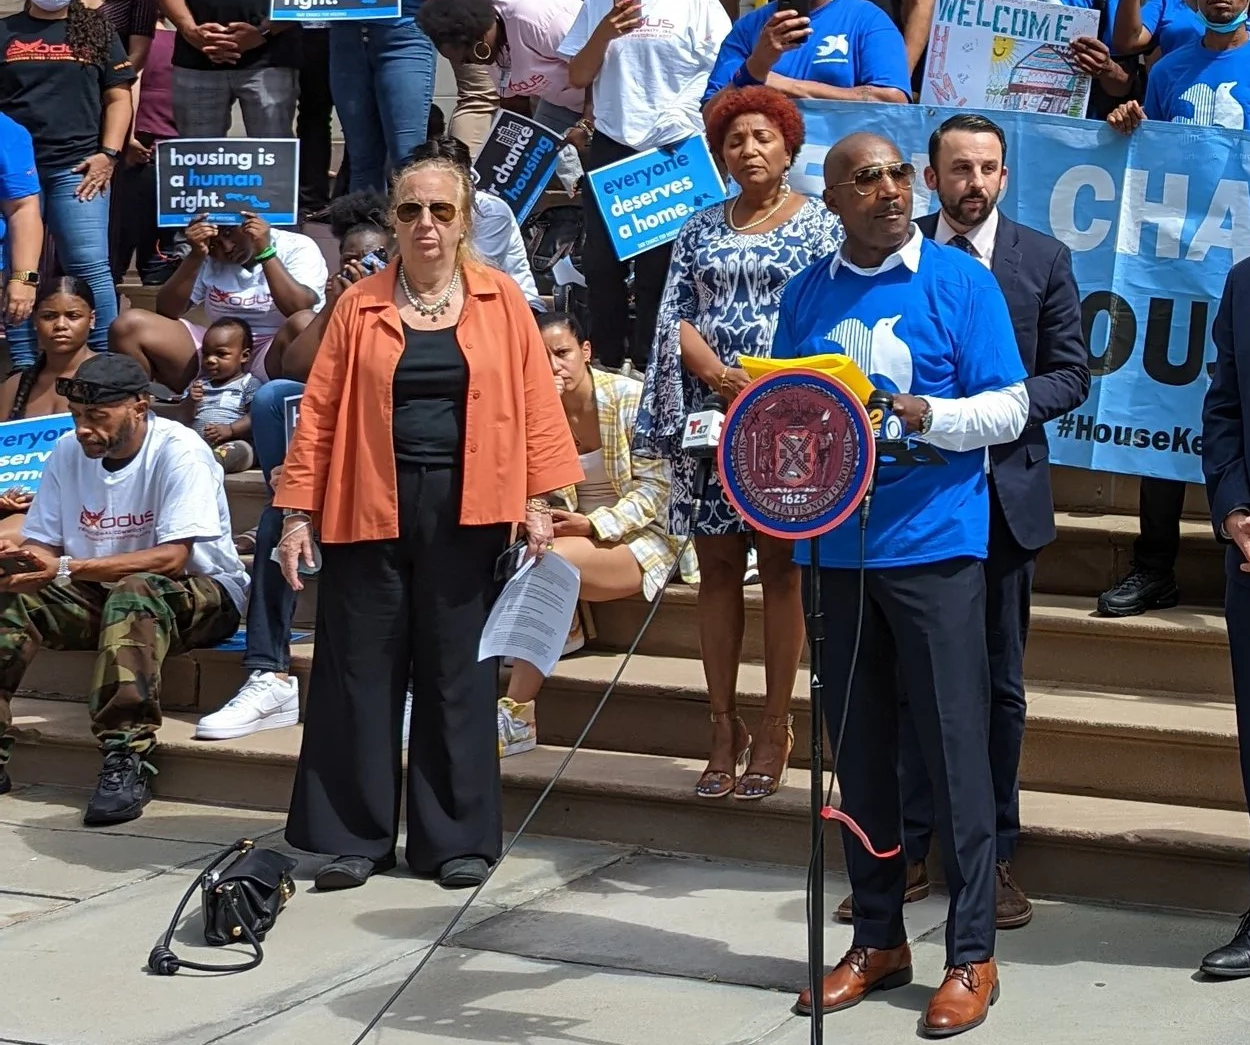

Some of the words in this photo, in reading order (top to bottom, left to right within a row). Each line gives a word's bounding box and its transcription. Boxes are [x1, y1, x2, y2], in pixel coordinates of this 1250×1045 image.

[170, 148, 252, 170] housing
[258, 148, 276, 166] is
[496, 126, 534, 184] chance
[504, 135, 555, 202] housing
[170, 176, 185, 188] a
[188, 170, 263, 188] human
[604, 153, 690, 195] everyone
[170, 190, 225, 213] right.
[611, 176, 694, 218] deserves
[618, 224, 632, 240] a
[635, 201, 695, 229] home.
[870, 408, 884, 429] 2
[782, 494, 808, 505] 1625
